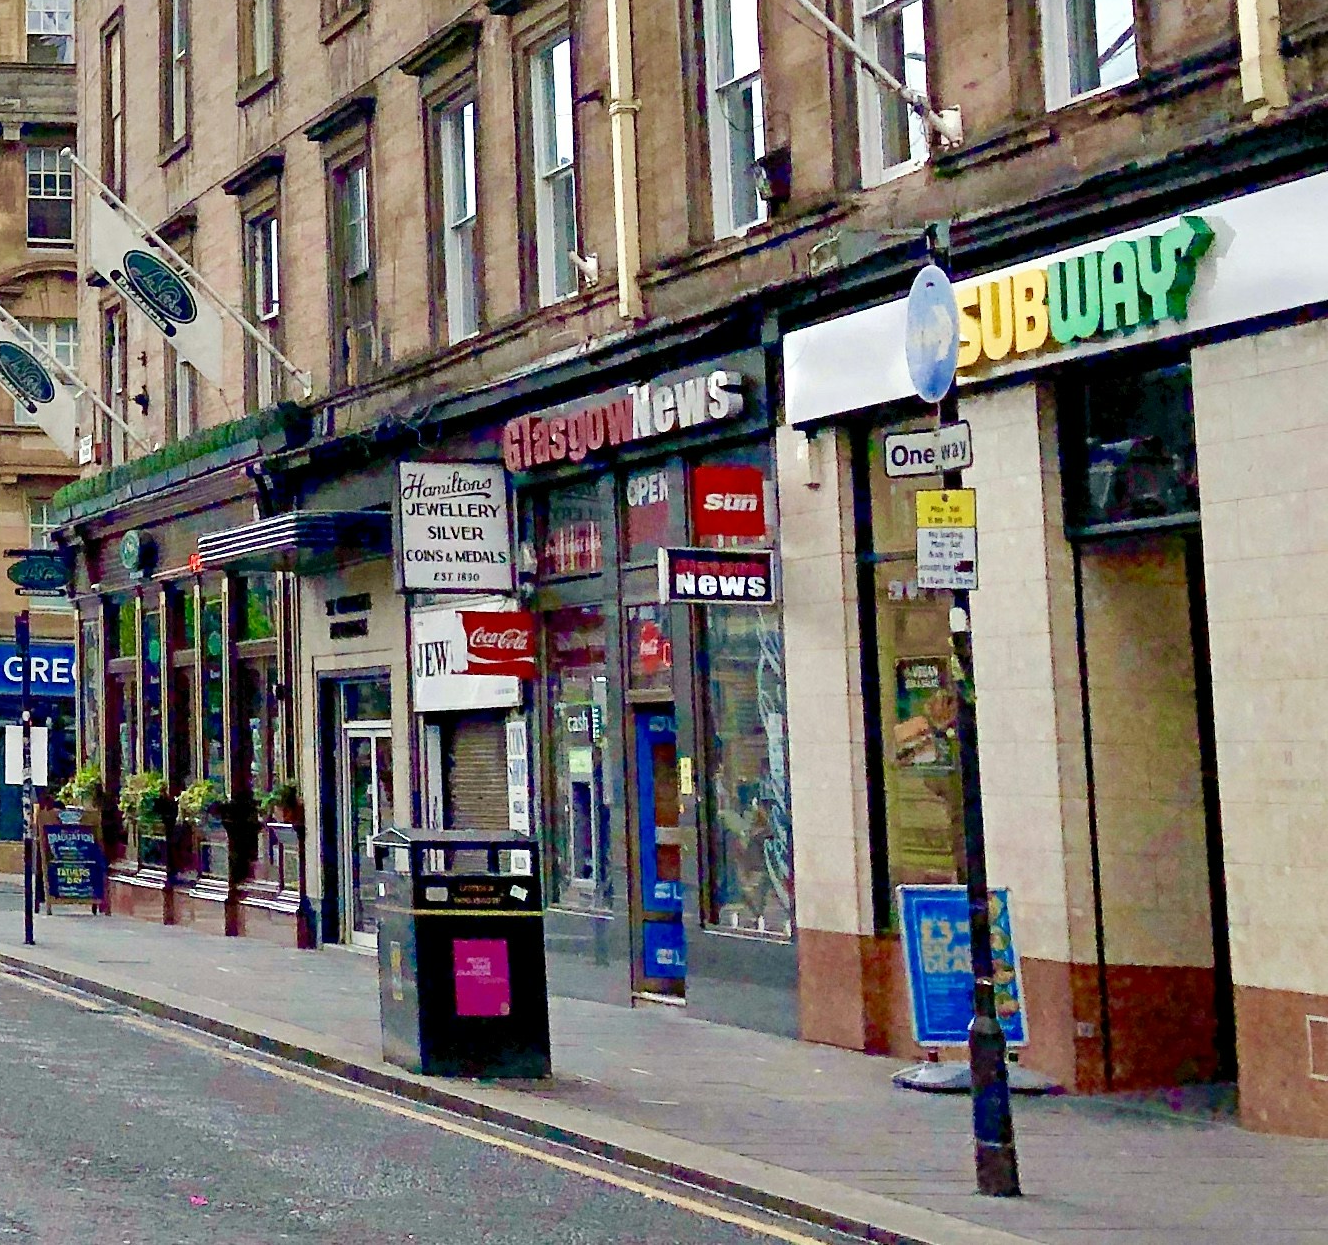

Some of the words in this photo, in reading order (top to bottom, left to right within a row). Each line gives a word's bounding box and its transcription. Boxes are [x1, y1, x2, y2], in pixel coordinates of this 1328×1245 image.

[956, 216, 1211, 368] SUBWAY
[502, 395, 634, 473] Glasgow
[628, 370, 739, 440] News
[891, 445, 935, 467] One
[940, 440, 966, 461] way
[402, 471, 492, 500] Hamiltons
[626, 471, 669, 507] OPEN
[406, 503, 500, 518] JEWELLERY
[427, 526, 484, 541] SILVER
[406, 549, 443, 562] COINS
[455, 550, 507, 564] MEDALS
[675, 572, 766, 597] News
[3, 656, 75, 684] GRE
[567, 710, 589, 733] cash
